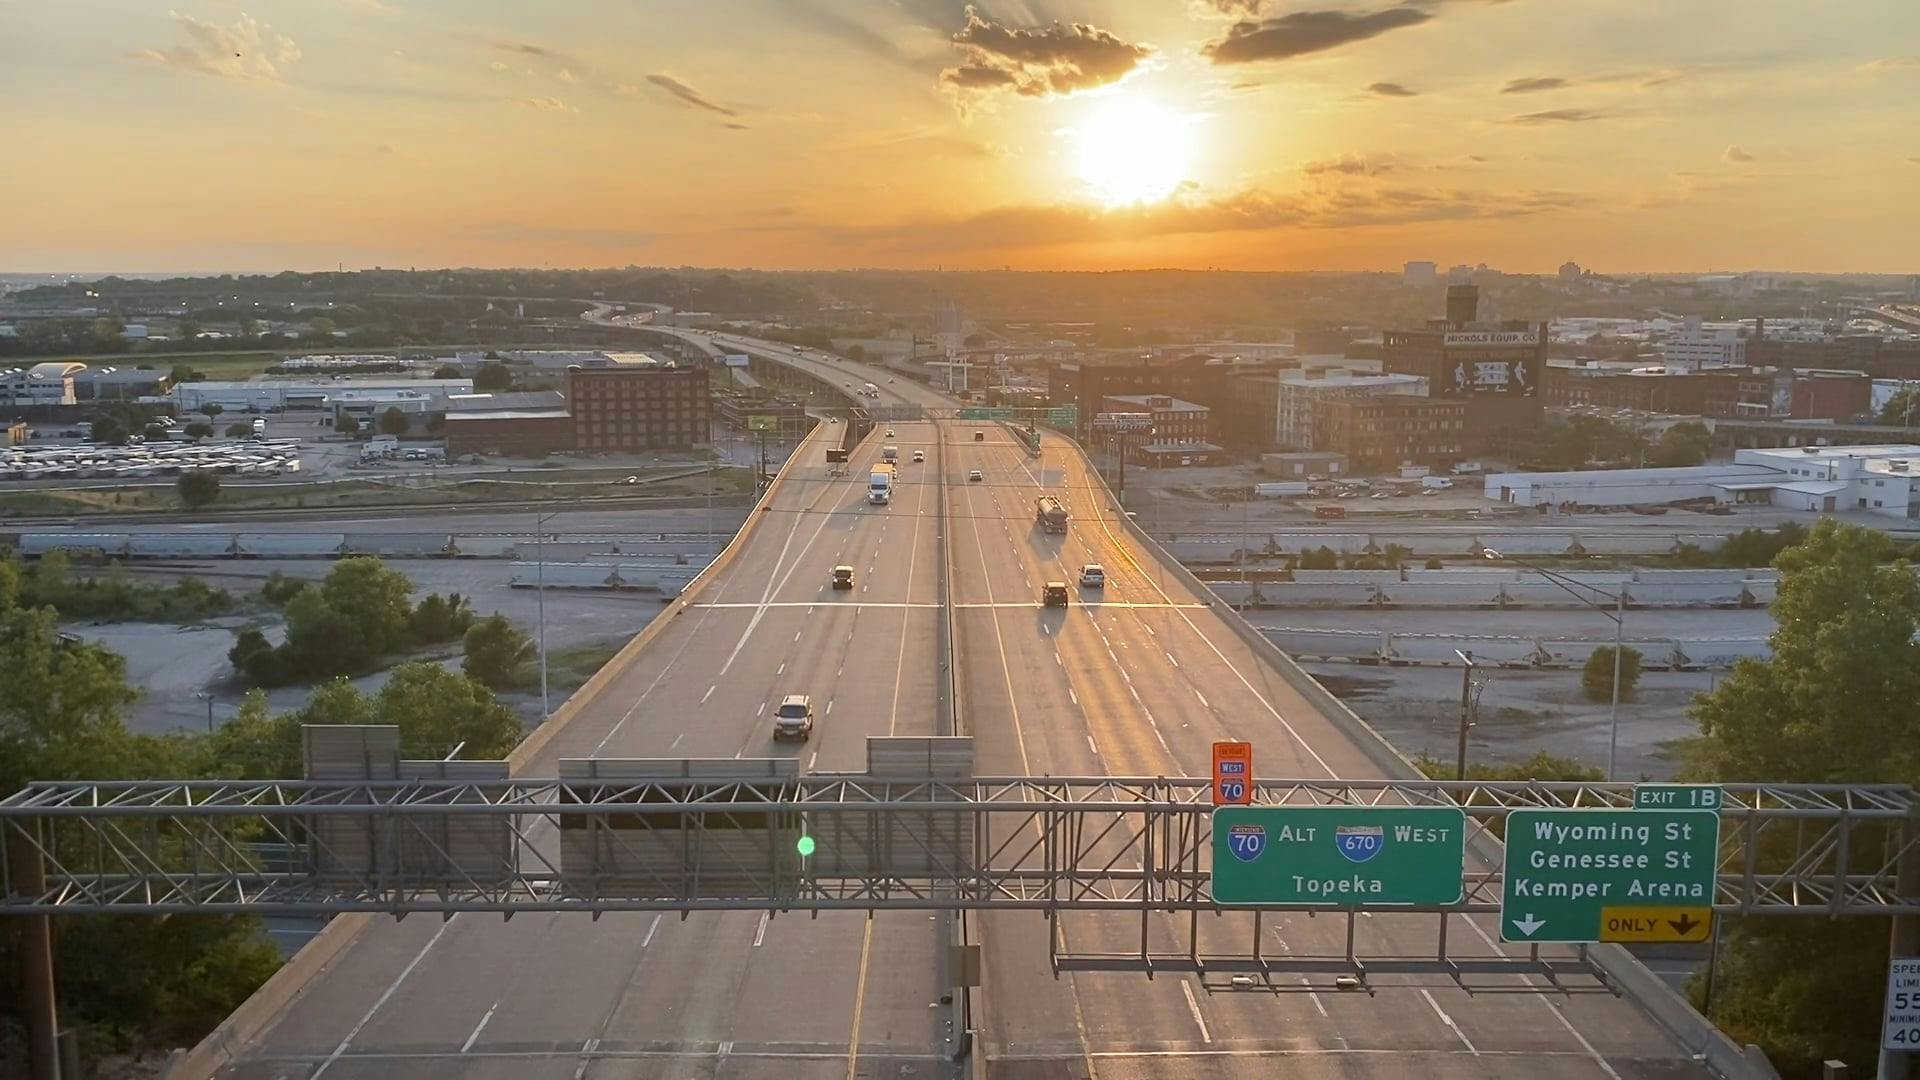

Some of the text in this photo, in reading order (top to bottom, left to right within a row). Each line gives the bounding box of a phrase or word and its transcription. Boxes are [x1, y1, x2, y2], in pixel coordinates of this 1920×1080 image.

[1222, 763, 1243, 773] WEST
[1222, 784, 1243, 799] 70
[1640, 789, 1716, 806] EXIT 1B
[1234, 825, 1450, 852] 70 ALT 670 WEST
[1534, 821, 1692, 846] Wyoming St
[1530, 850, 1692, 869] Genessee St
[1293, 874, 1383, 897] Topeka
[1515, 878, 1704, 900] Kemper Arena
[1608, 918, 1659, 932] ONLY
[1892, 964, 1920, 974] SPEE
[1896, 979, 1920, 988] LIMI
[1895, 993, 1920, 1010] 55
[1889, 1015, 1920, 1024] MINIMU
[1893, 1028, 1920, 1044] 40
